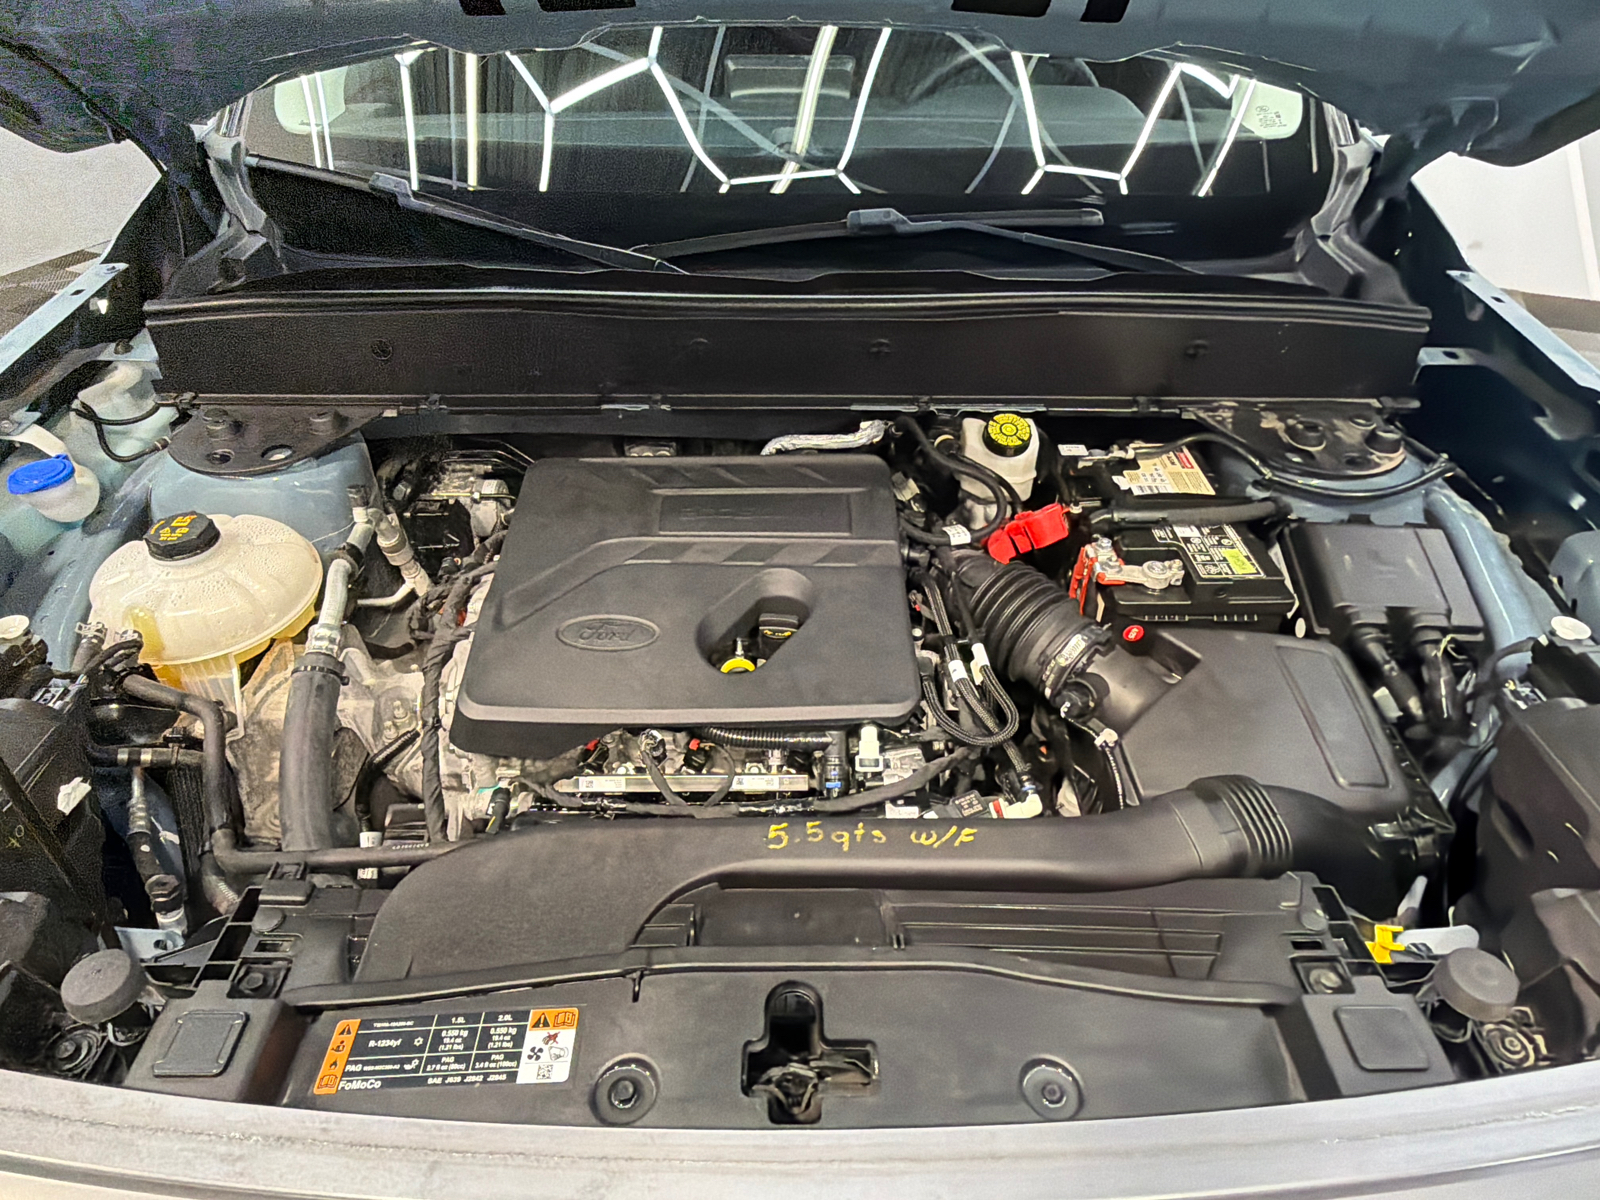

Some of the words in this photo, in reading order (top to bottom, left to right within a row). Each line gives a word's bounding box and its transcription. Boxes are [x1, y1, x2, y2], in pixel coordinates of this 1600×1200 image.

[579, 622, 636, 642] Ford
[766, 820, 824, 850] 5.5
[497, 1013, 513, 1021] 2.0L
[459, 1029, 469, 1037] kg
[508, 1026, 517, 1035] kg
[368, 1038, 403, 1048] R-1234yf
[344, 1064, 362, 1072] PAG
[338, 1079, 382, 1090] FoMoCo
